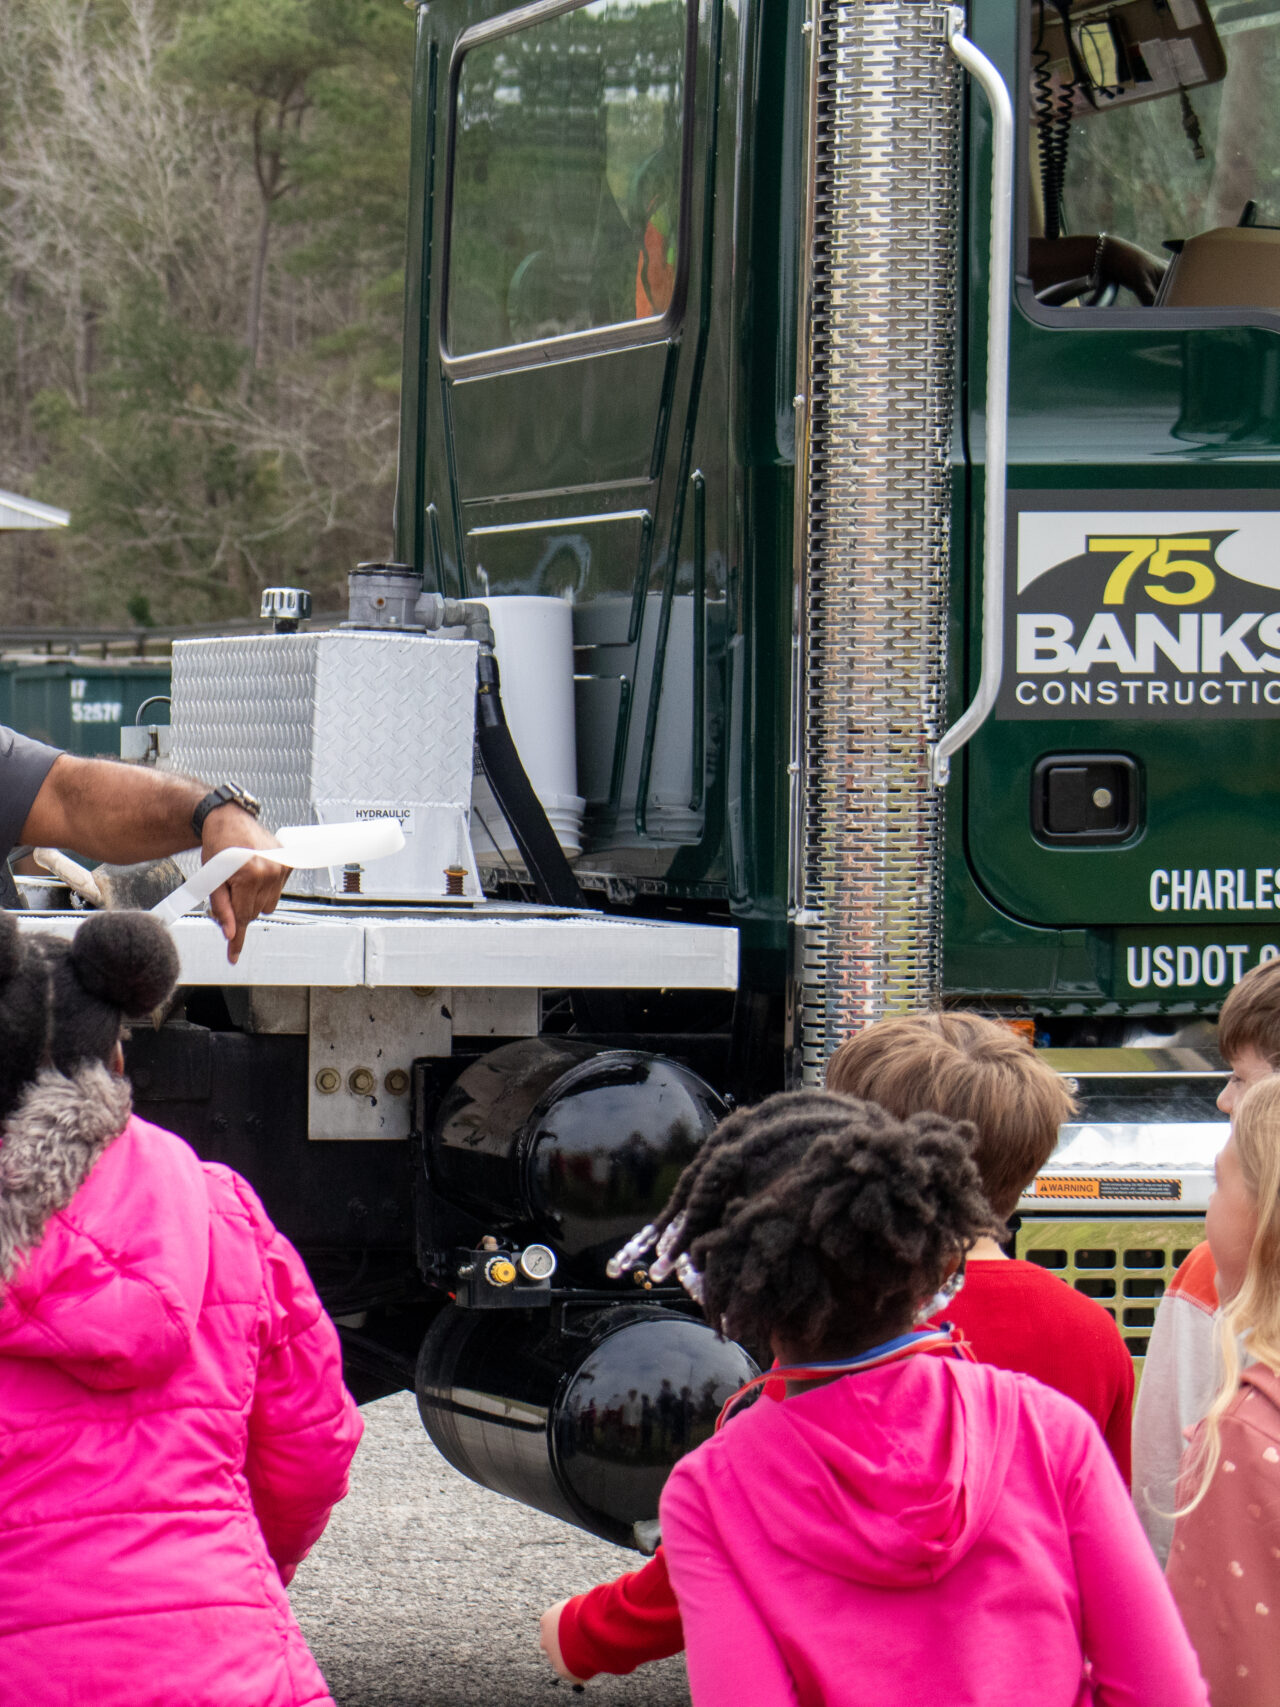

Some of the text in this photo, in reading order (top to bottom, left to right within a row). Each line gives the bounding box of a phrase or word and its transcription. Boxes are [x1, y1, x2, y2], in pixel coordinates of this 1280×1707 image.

[1089, 538, 1216, 605] 75
[356, 809, 411, 818] HYDRAULIC
[1127, 944, 1249, 988] USDOT
[1049, 1183, 1094, 1193] WARNING
